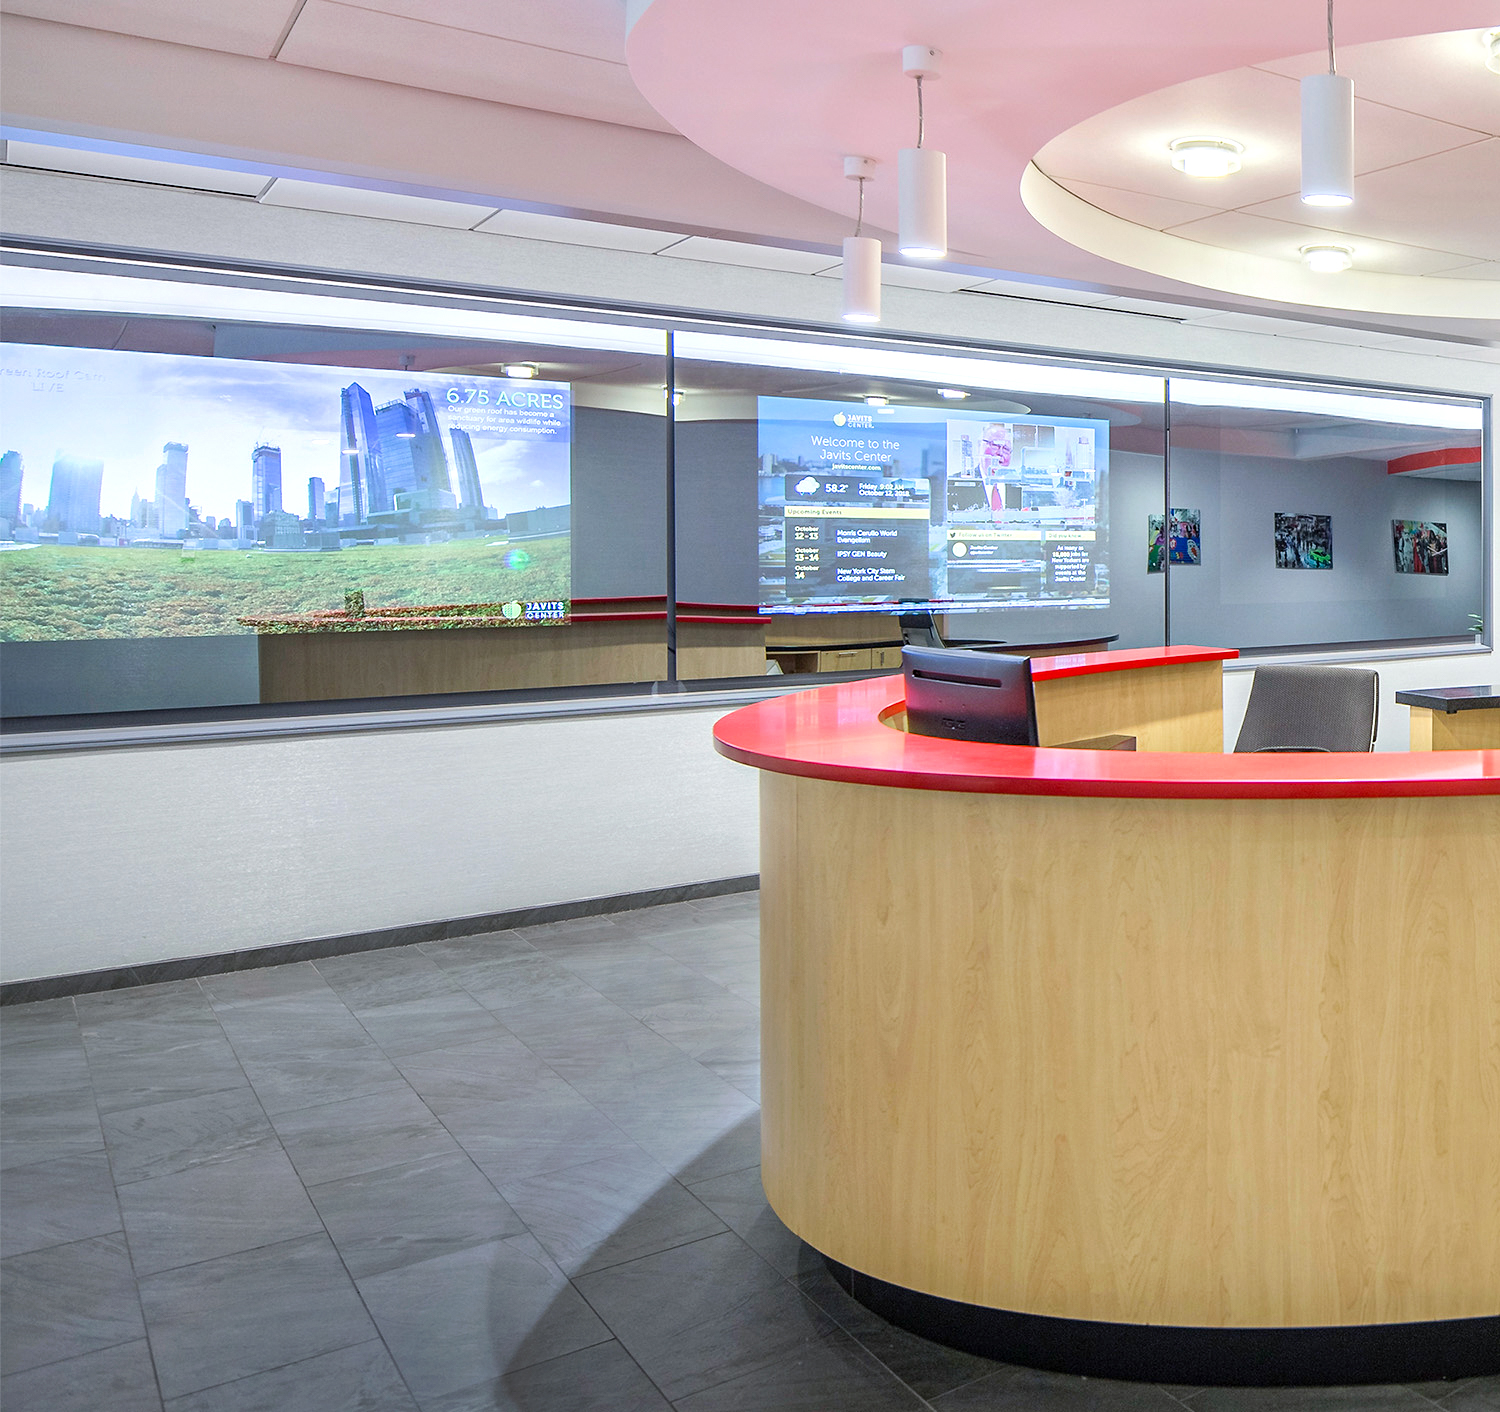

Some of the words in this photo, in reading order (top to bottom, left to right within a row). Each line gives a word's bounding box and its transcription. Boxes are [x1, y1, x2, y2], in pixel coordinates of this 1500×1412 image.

[446, 388, 490, 405] 6.75
[496, 391, 564, 409] ACRES
[464, 407, 486, 415] green
[448, 415, 484, 424] sanctuary
[516, 417, 540, 425] wildlife
[848, 414, 872, 422] JAVITS
[482, 425, 508, 433] energy
[810, 435, 865, 449] Welcome
[867, 439, 879, 449] to
[882, 439, 900, 450] the
[819, 449, 852, 460] Javits
[854, 451, 892, 462] Center
[526, 602, 564, 610] JAVITS
